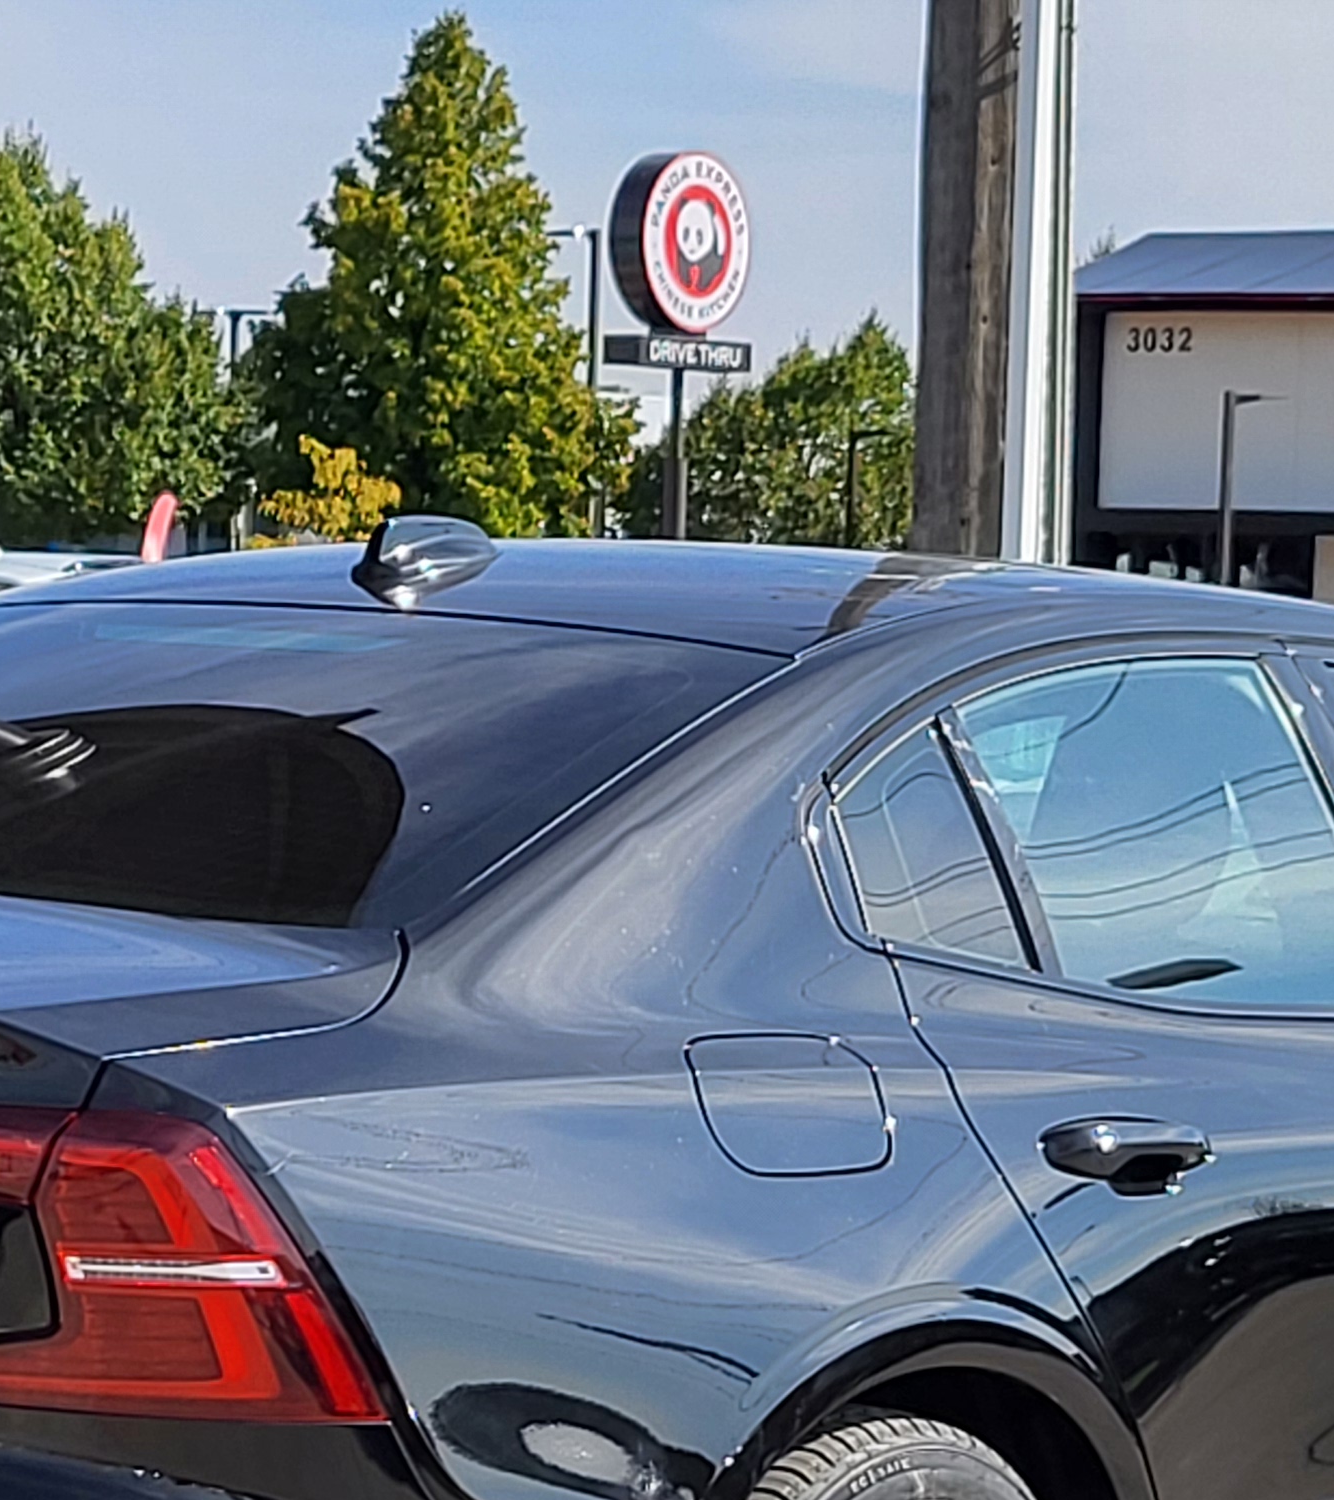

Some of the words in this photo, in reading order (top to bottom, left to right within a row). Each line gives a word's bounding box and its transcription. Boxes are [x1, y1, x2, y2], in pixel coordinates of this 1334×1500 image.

[651, 164, 690, 227] PANDA
[695, 161, 744, 236] EXPRESS
[649, 339, 697, 364] DRIVE
[696, 343, 743, 369] THRU
[1126, 326, 1193, 353] 3032
